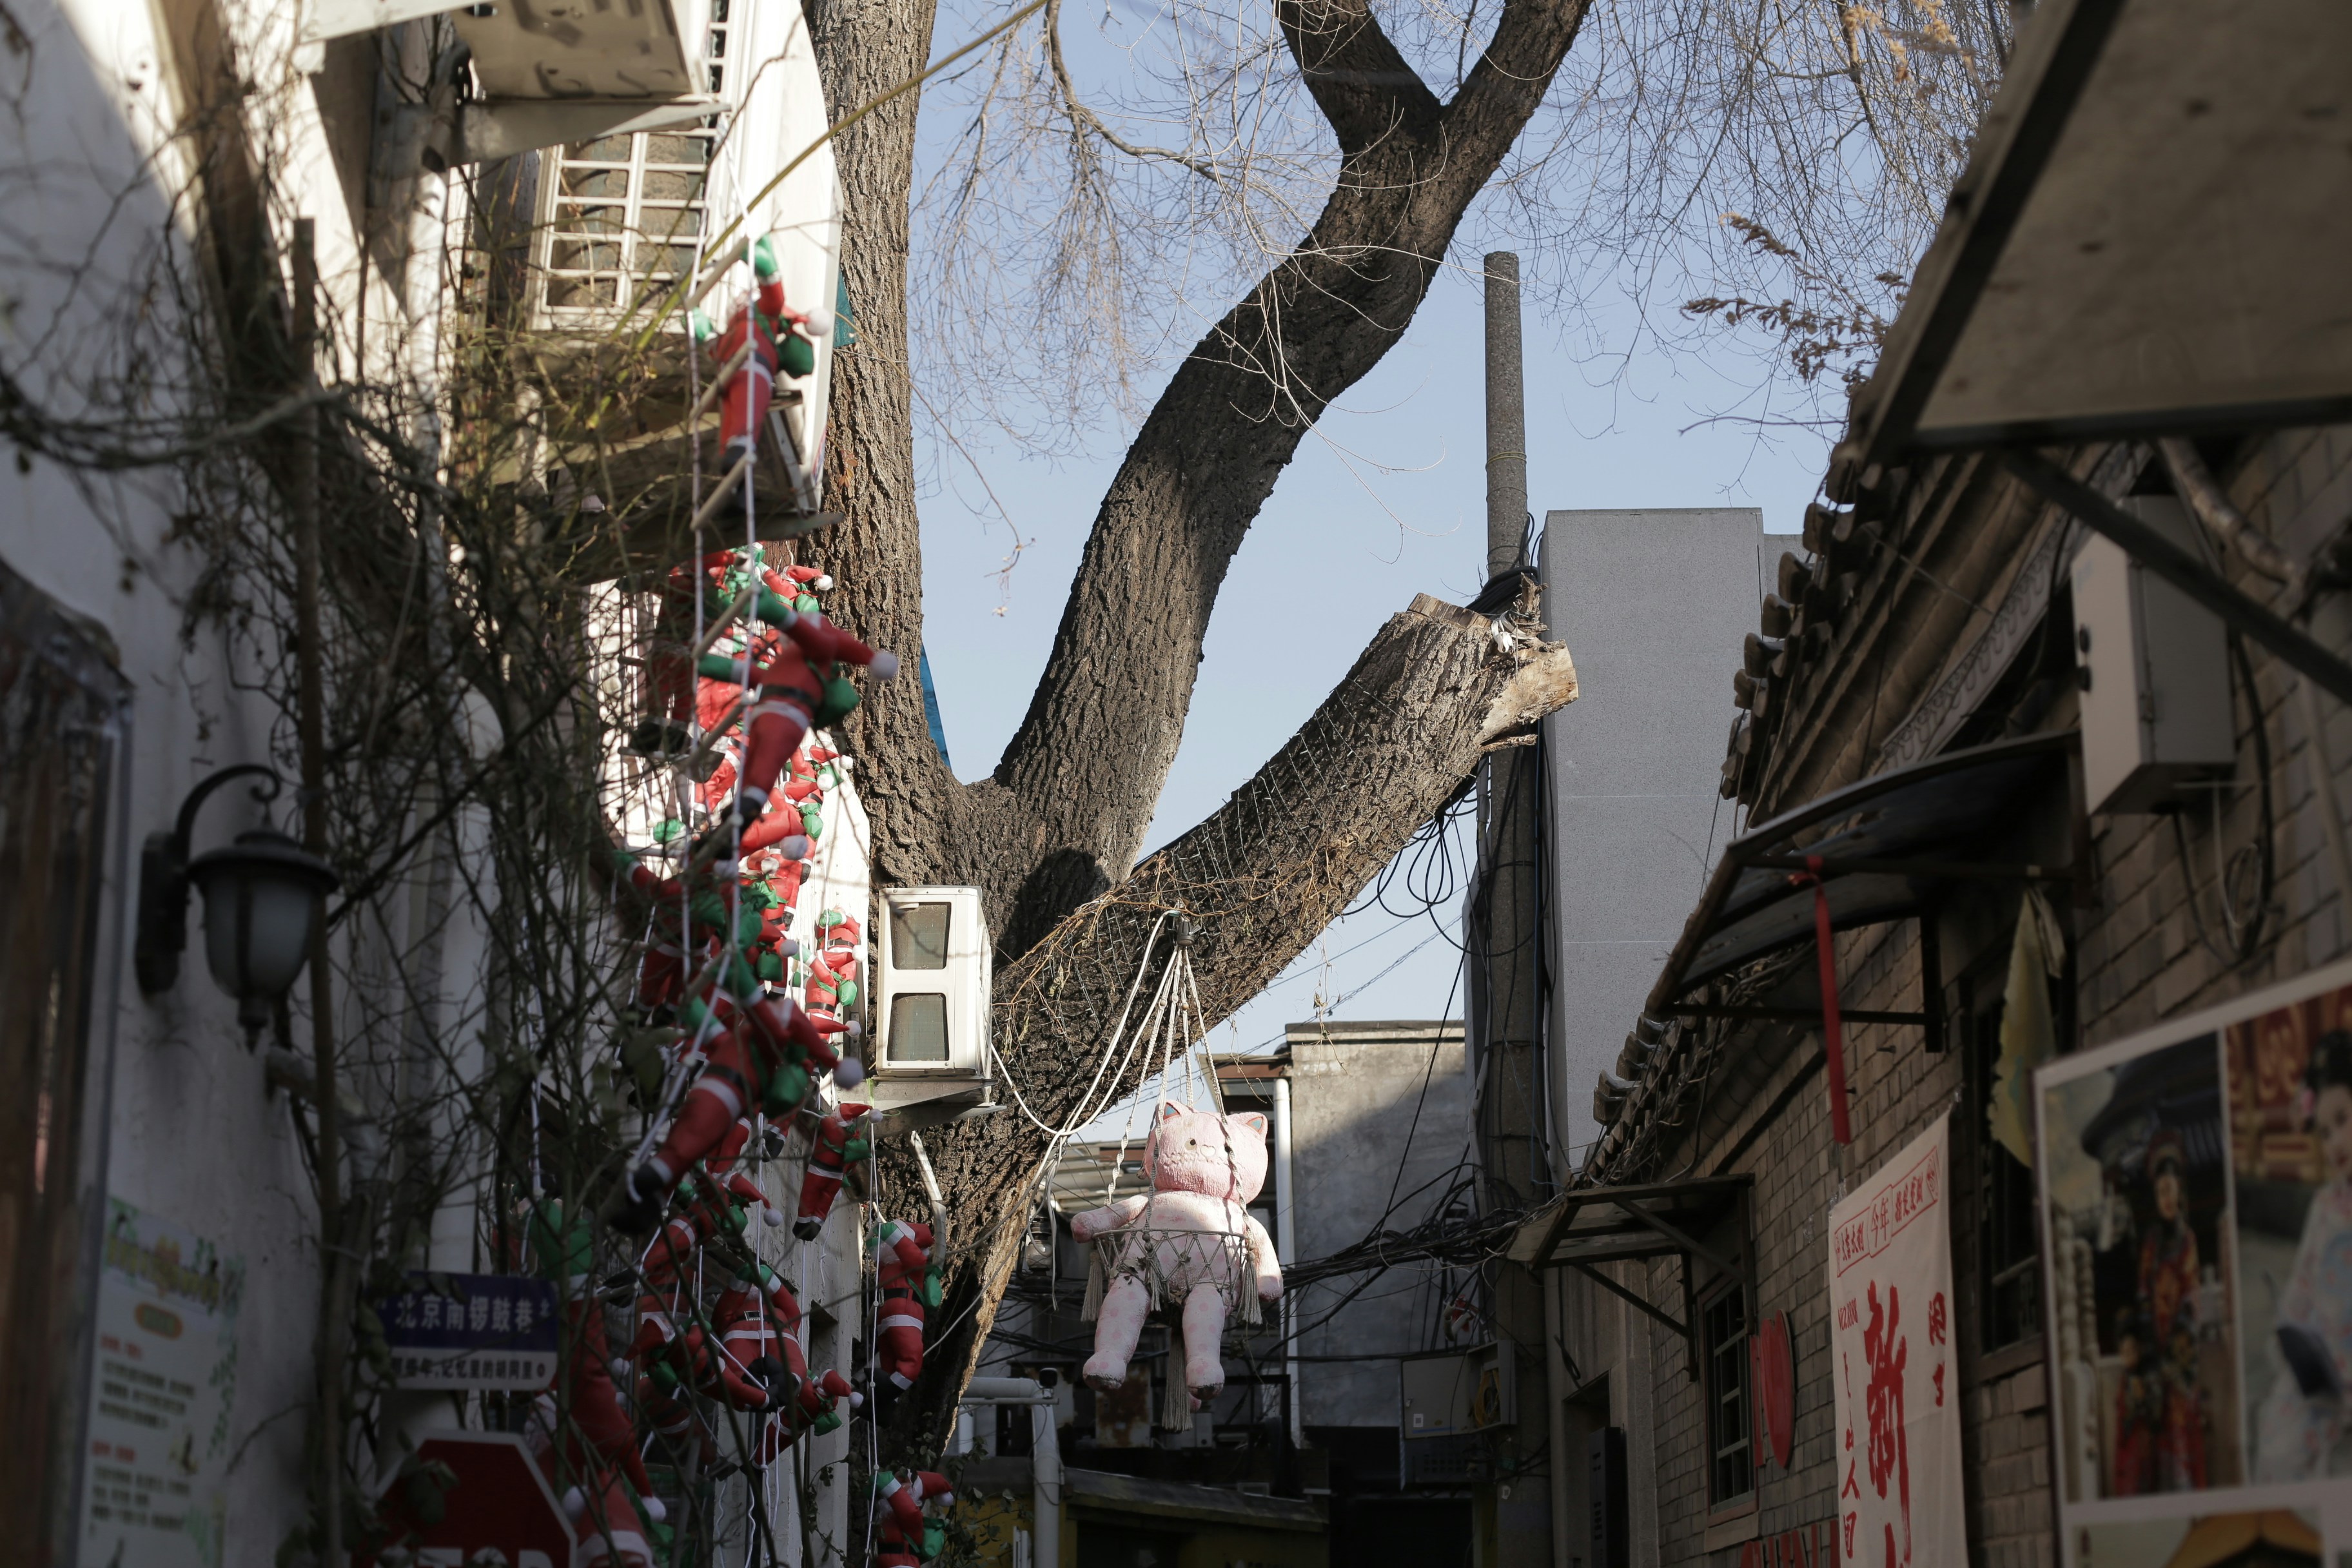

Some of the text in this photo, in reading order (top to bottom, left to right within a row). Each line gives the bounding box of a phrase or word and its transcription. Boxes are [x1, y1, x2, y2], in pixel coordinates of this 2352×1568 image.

[1871, 1197, 1890, 1248] 今年
[395, 1293, 534, 1333] 北京南锣鼓巷
